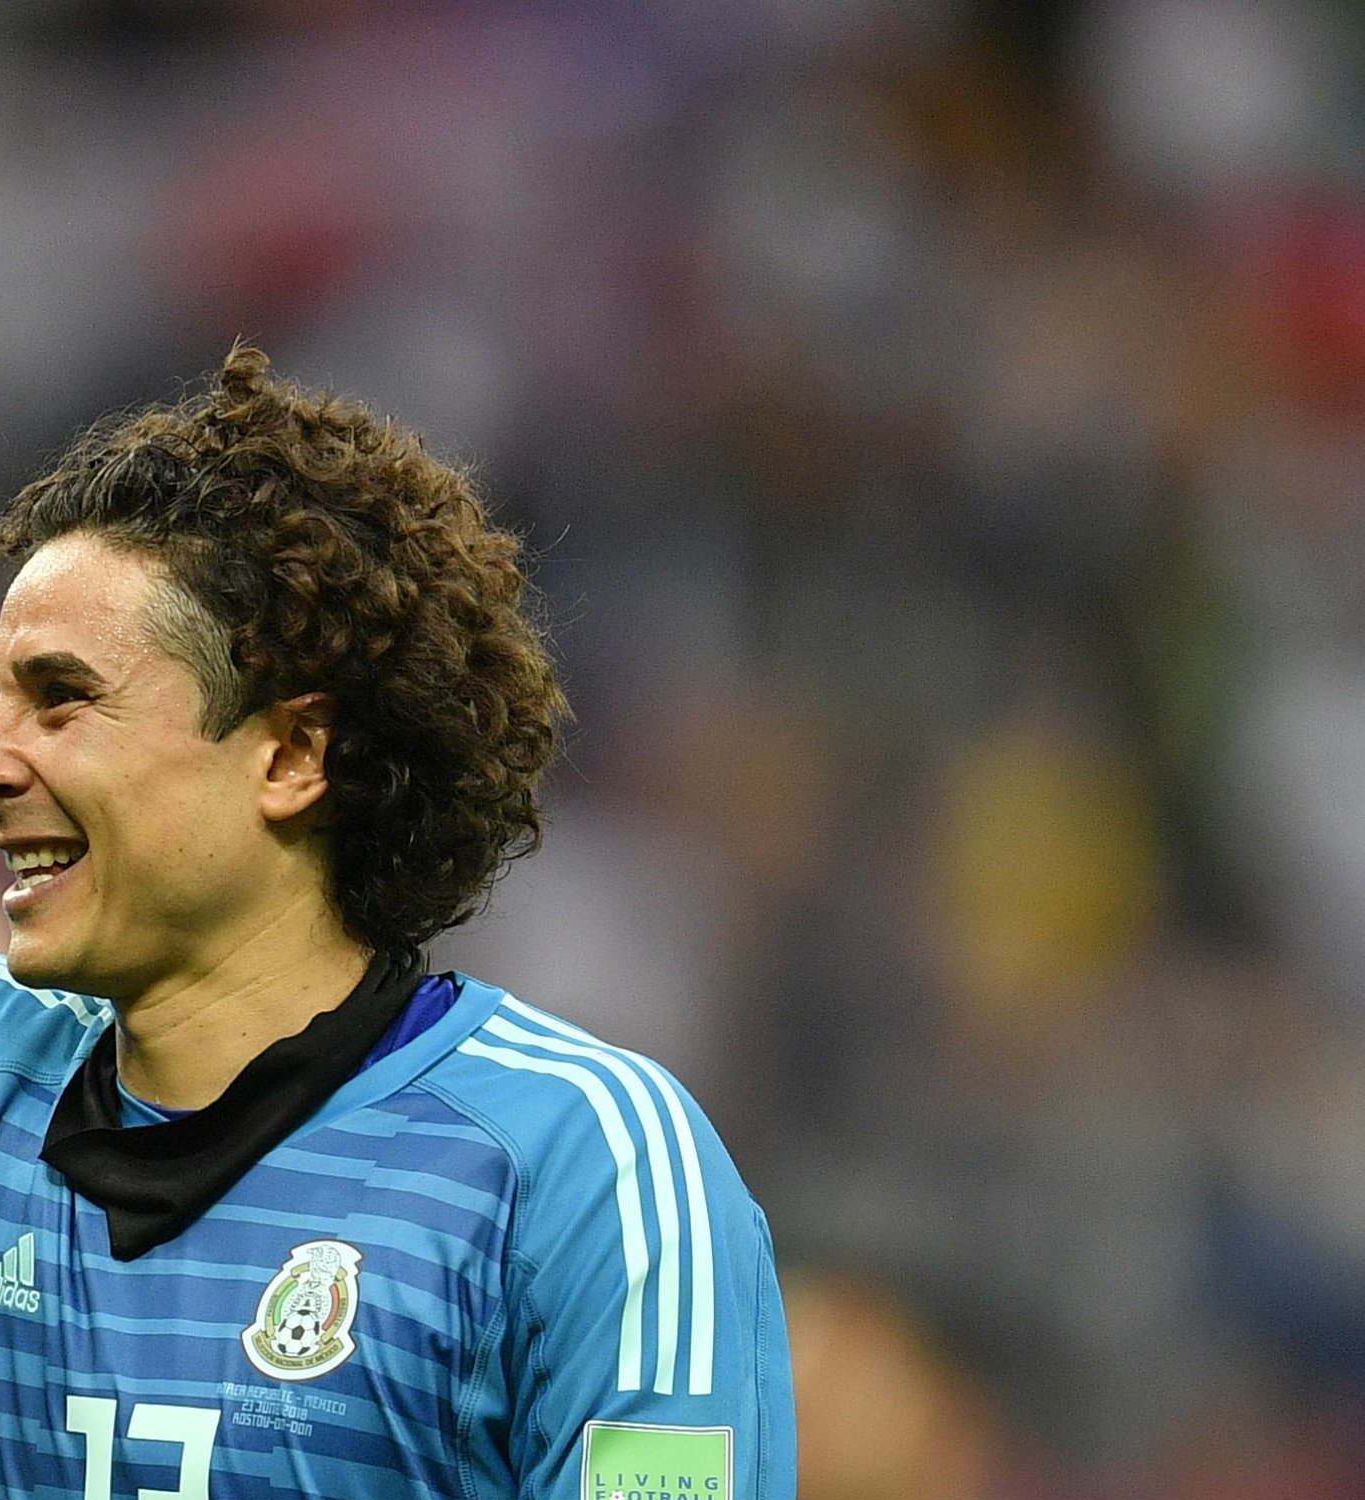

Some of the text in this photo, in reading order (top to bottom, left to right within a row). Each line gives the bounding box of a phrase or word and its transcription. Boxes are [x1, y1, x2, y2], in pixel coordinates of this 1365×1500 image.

[247, 1385, 294, 1404] REPUBLIC
[303, 1394, 347, 1416] MEXICO
[254, 1399, 281, 1416] JUNE
[282, 1403, 308, 1421] 2018
[596, 1473, 719, 1490] LIVING
